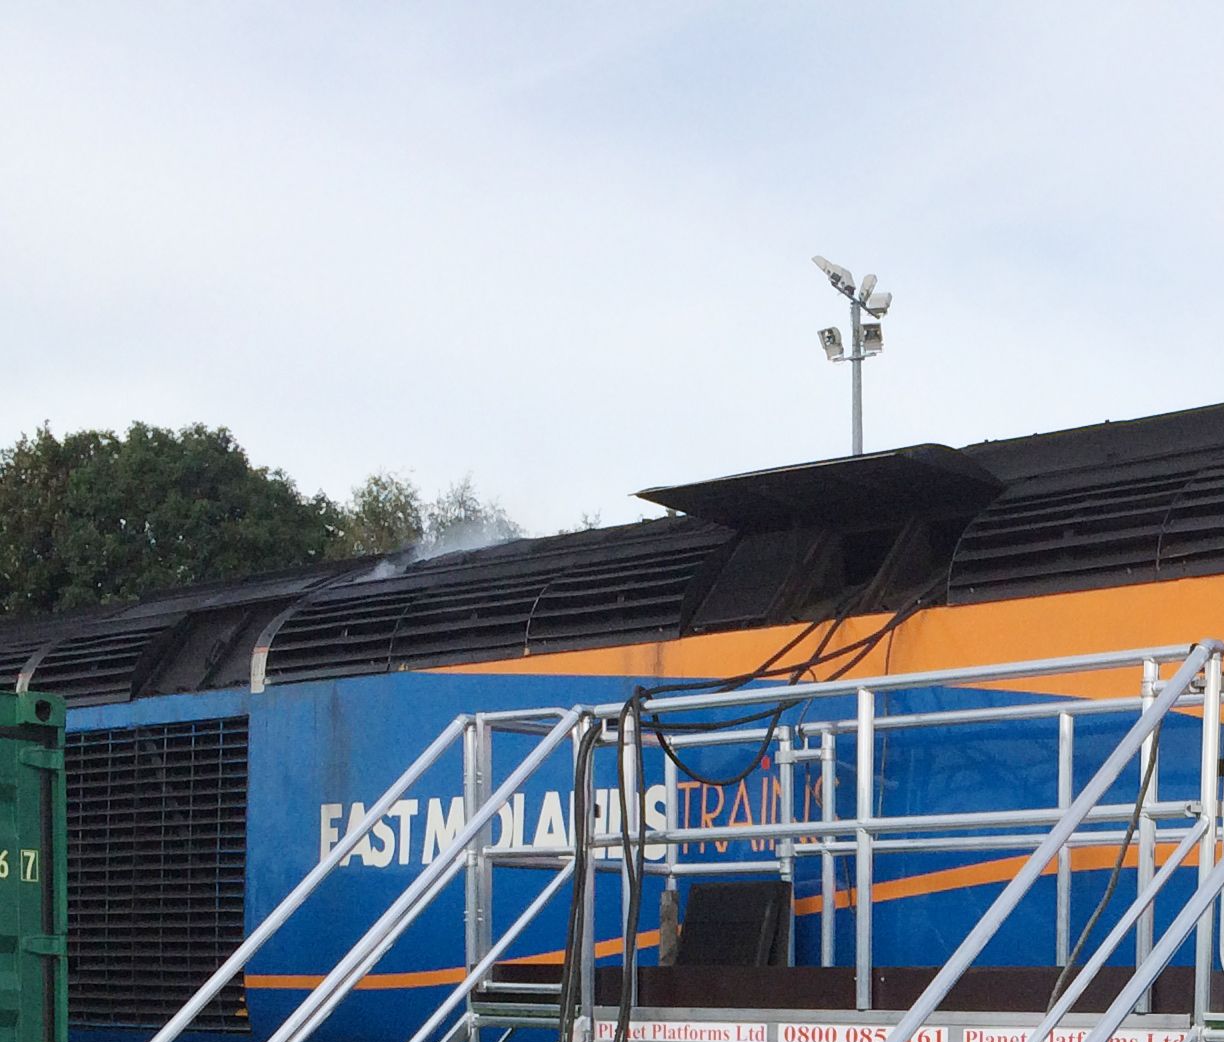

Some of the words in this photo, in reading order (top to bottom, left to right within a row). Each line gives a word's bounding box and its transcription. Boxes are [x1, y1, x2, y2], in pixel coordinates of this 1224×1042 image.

[422, 785, 668, 865] MDLAS
[599, 1023, 646, 1040] Plet
[652, 1023, 730, 1041] Platforms
[736, 1025, 765, 1042] Ltd
